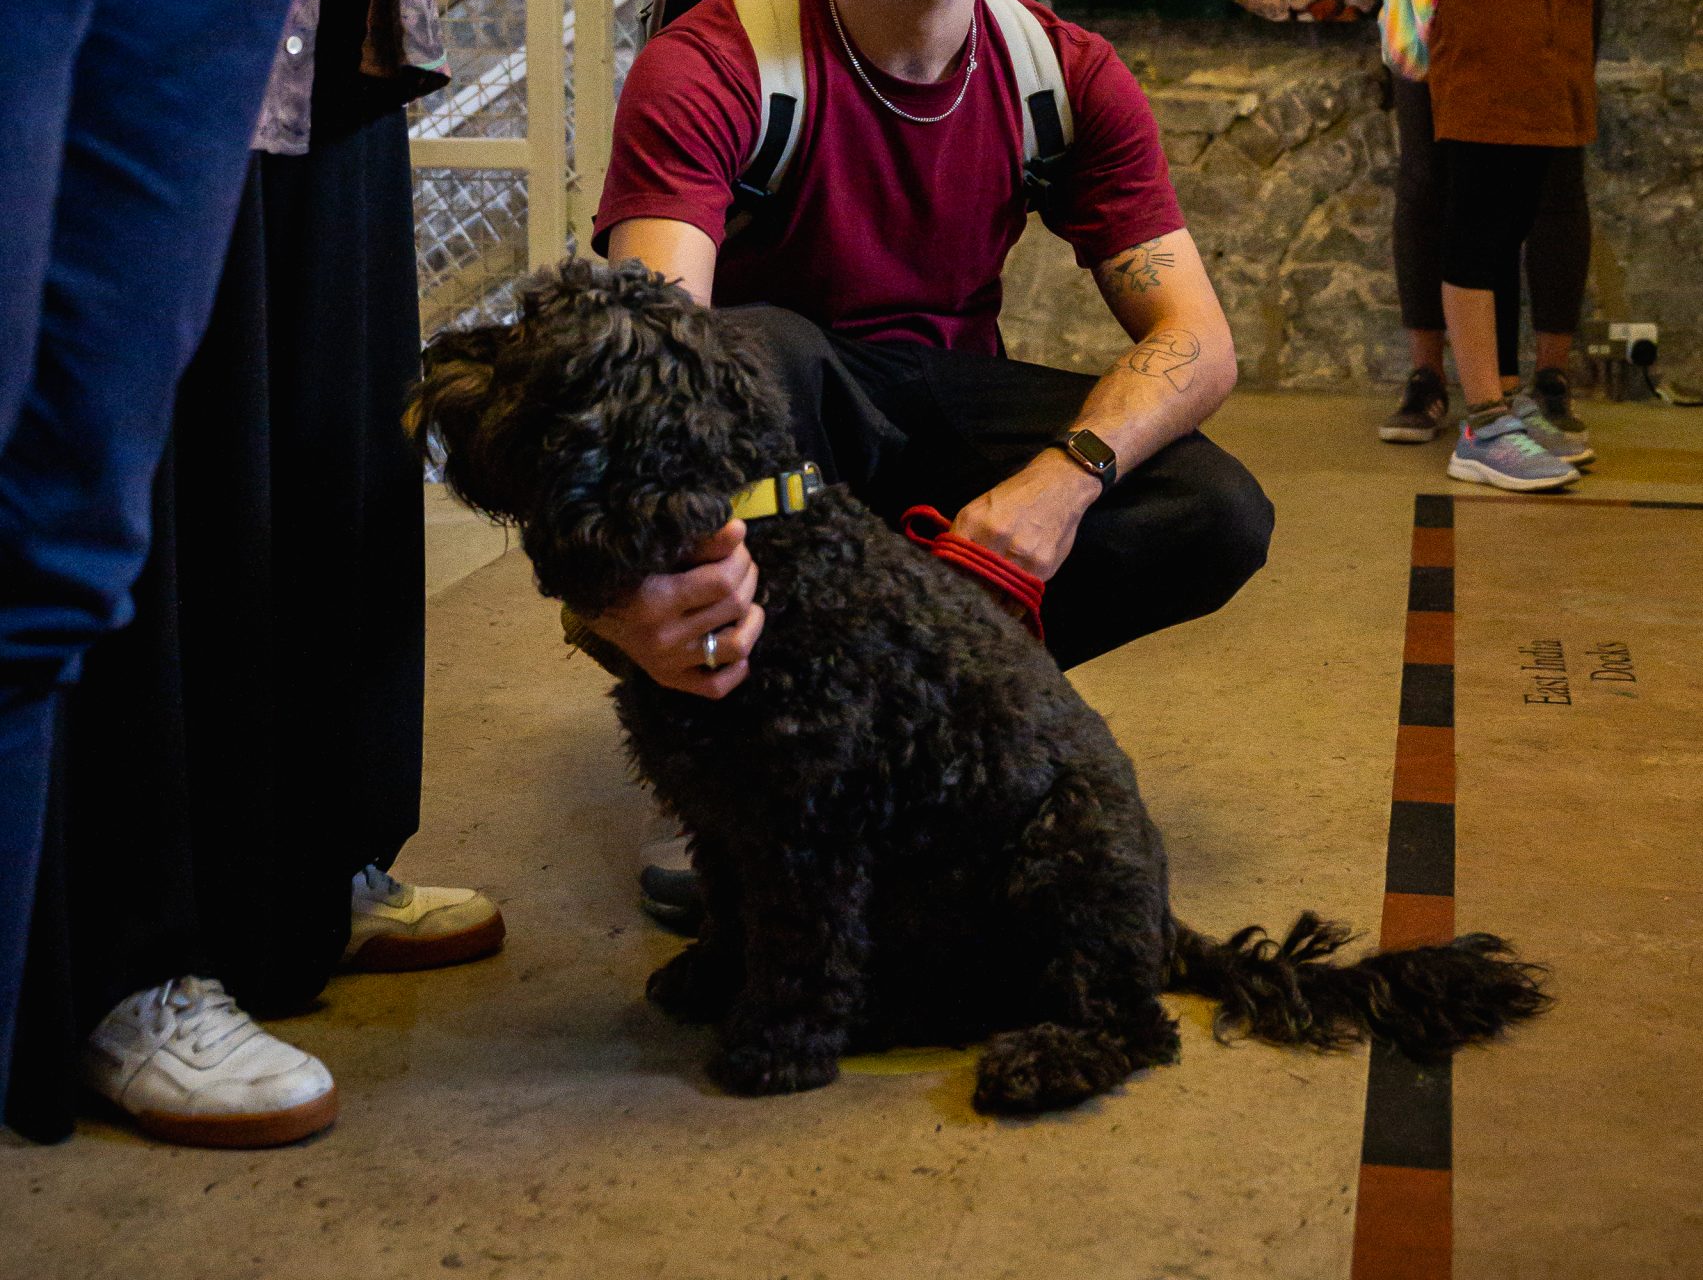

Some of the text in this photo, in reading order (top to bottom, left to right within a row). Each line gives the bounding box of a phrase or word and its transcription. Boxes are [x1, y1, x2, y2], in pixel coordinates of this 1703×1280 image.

[1518, 639, 1572, 706] East India
[1585, 642, 1637, 683] Docks
